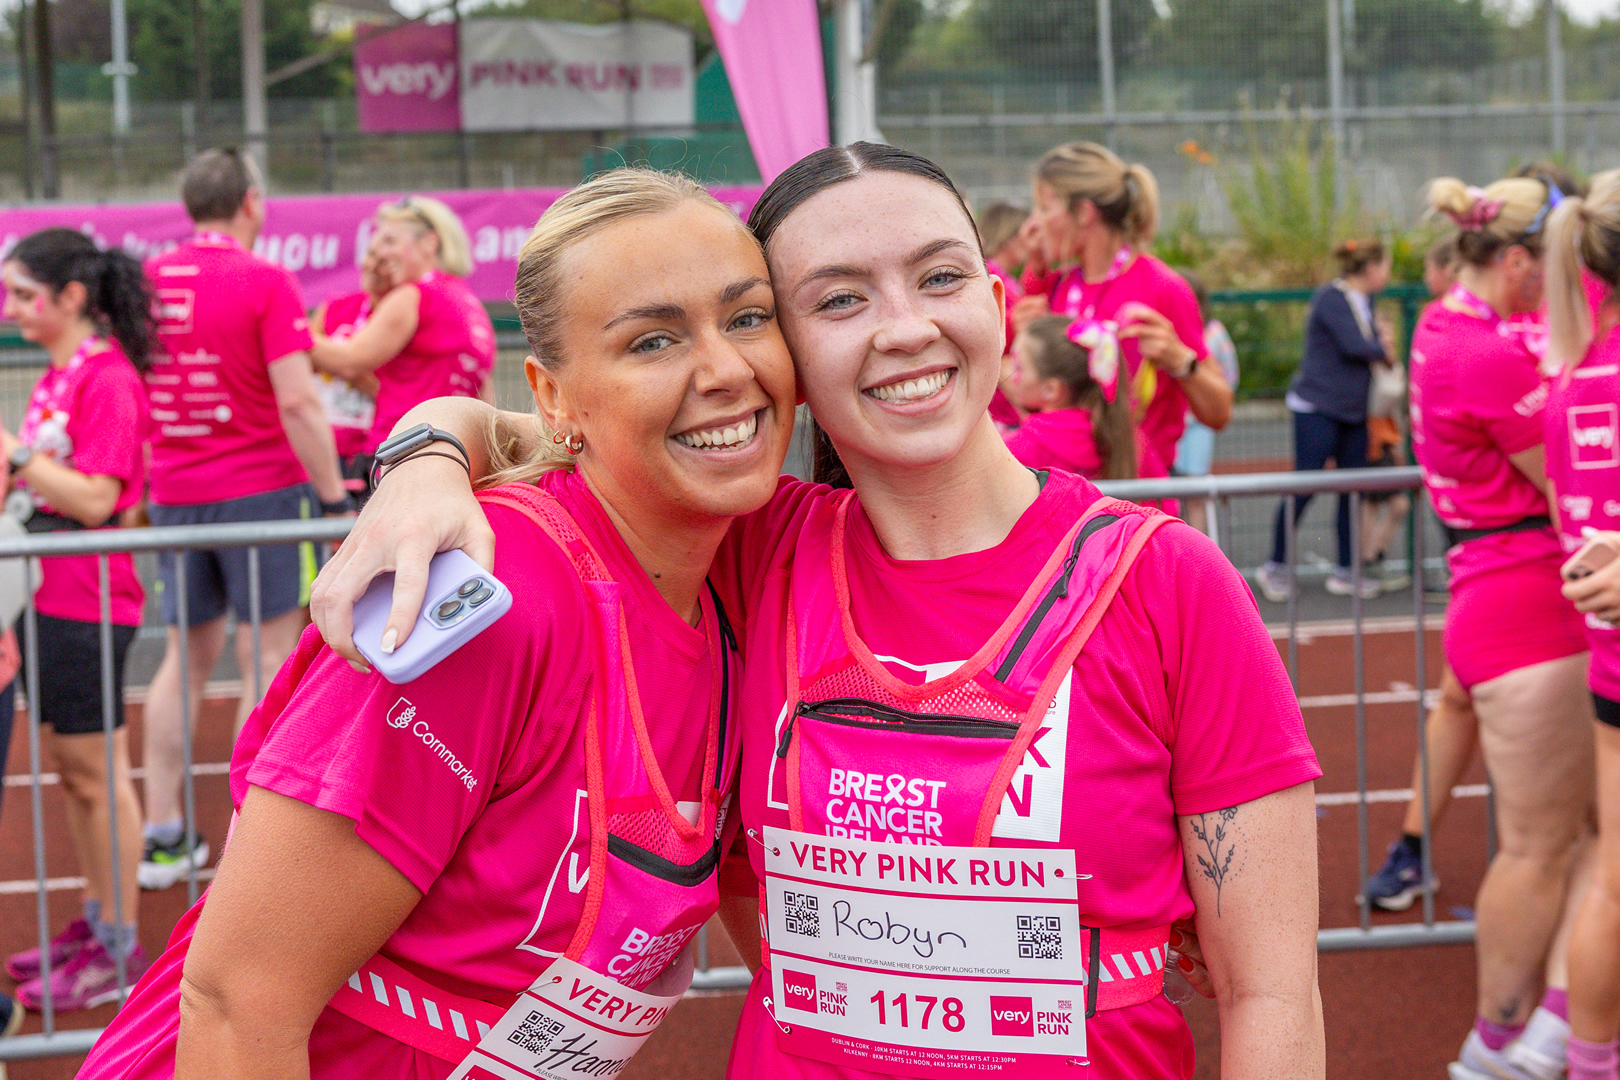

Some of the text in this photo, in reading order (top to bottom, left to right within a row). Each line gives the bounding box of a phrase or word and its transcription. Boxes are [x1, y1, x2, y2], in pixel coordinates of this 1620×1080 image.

[361, 62, 456, 101] very
[467, 59, 558, 89] PINK
[565, 61, 643, 92] RUN
[413, 721, 478, 793] Cornmarket
[826, 798, 943, 837] CANCER
[789, 840, 1045, 888] VERY PINK RUN
[832, 900, 967, 958] Robyn
[828, 951, 847, 961] PLEASE
[847, 955, 863, 964] WRITE
[864, 958, 879, 966] YOUR
[880, 960, 896, 968] NAME
[897, 962, 911, 970] HERE
[568, 977, 643, 1023] VERY
[785, 983, 815, 1001] very
[819, 990, 848, 1006] PINK
[820, 1001, 846, 1017] RUN
[870, 989, 966, 1033] 1178
[993, 1010, 1031, 1025] very
[1037, 1011, 1073, 1024] PINK
[1038, 1023, 1069, 1036] RUN
[831, 1037, 850, 1047] DUBLIN
[856, 1042, 870, 1050] CORK
[890, 1048, 910, 1056] STARTS
[926, 1052, 946, 1061] NOON,
[992, 1056, 1017, 1064] 12:30PM
[843, 1048, 868, 1058] KILKENNY
[884, 1055, 905, 1064] STARTS
[913, 1059, 933, 1068] NOON,
[946, 1062, 968, 1070] STARTS
[536, 1068, 554, 1078] PLEASE
